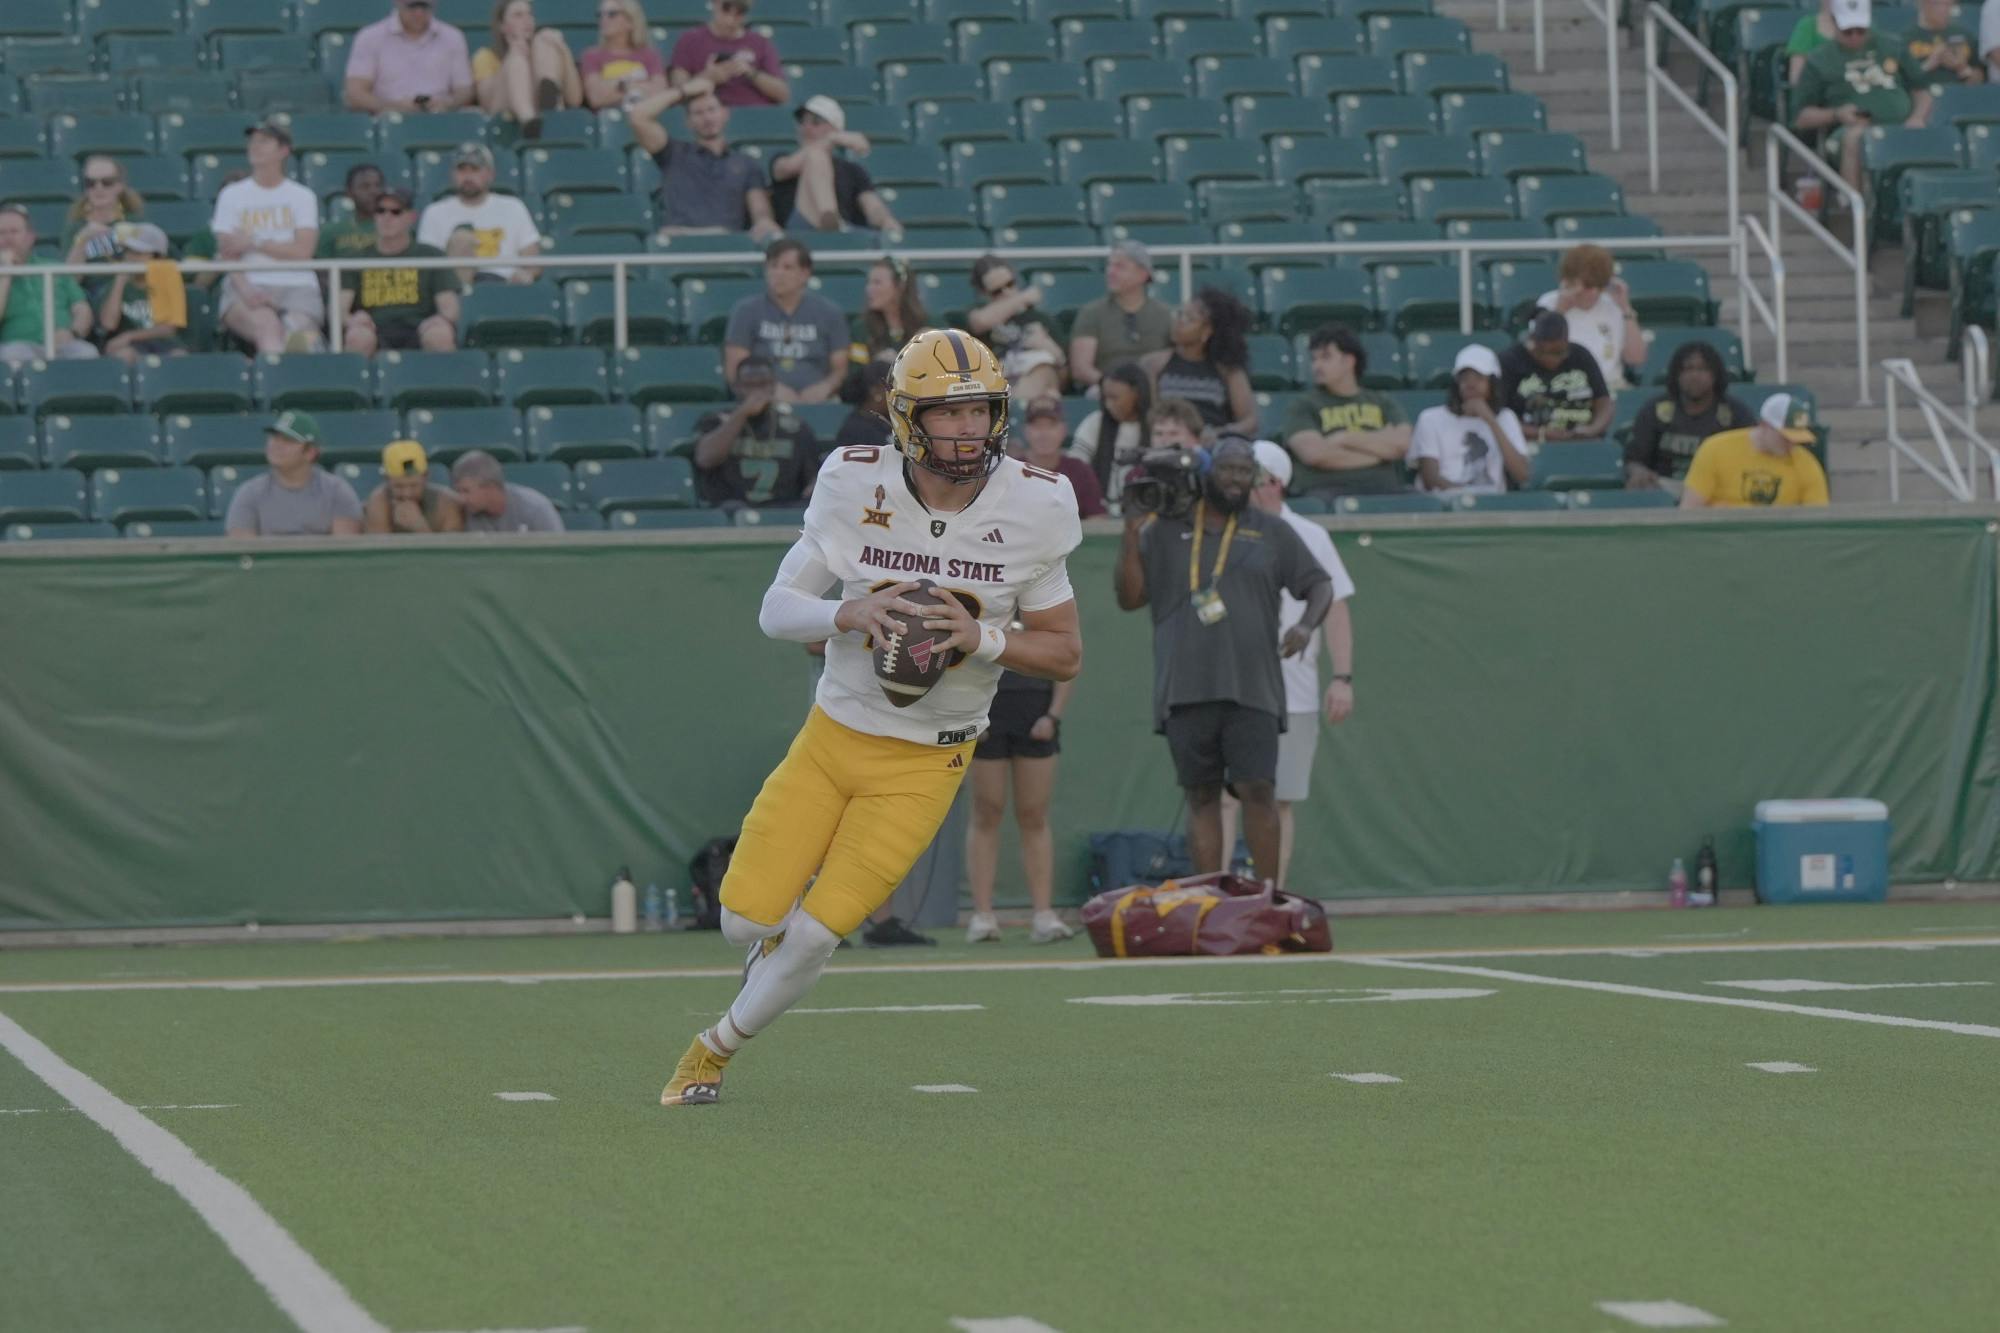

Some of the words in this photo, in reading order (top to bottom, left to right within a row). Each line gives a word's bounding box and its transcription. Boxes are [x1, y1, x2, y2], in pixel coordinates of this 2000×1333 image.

[739, 459, 779, 503] 7
[858, 545, 941, 576] ARIZONA
[946, 557, 1005, 583] STATE
